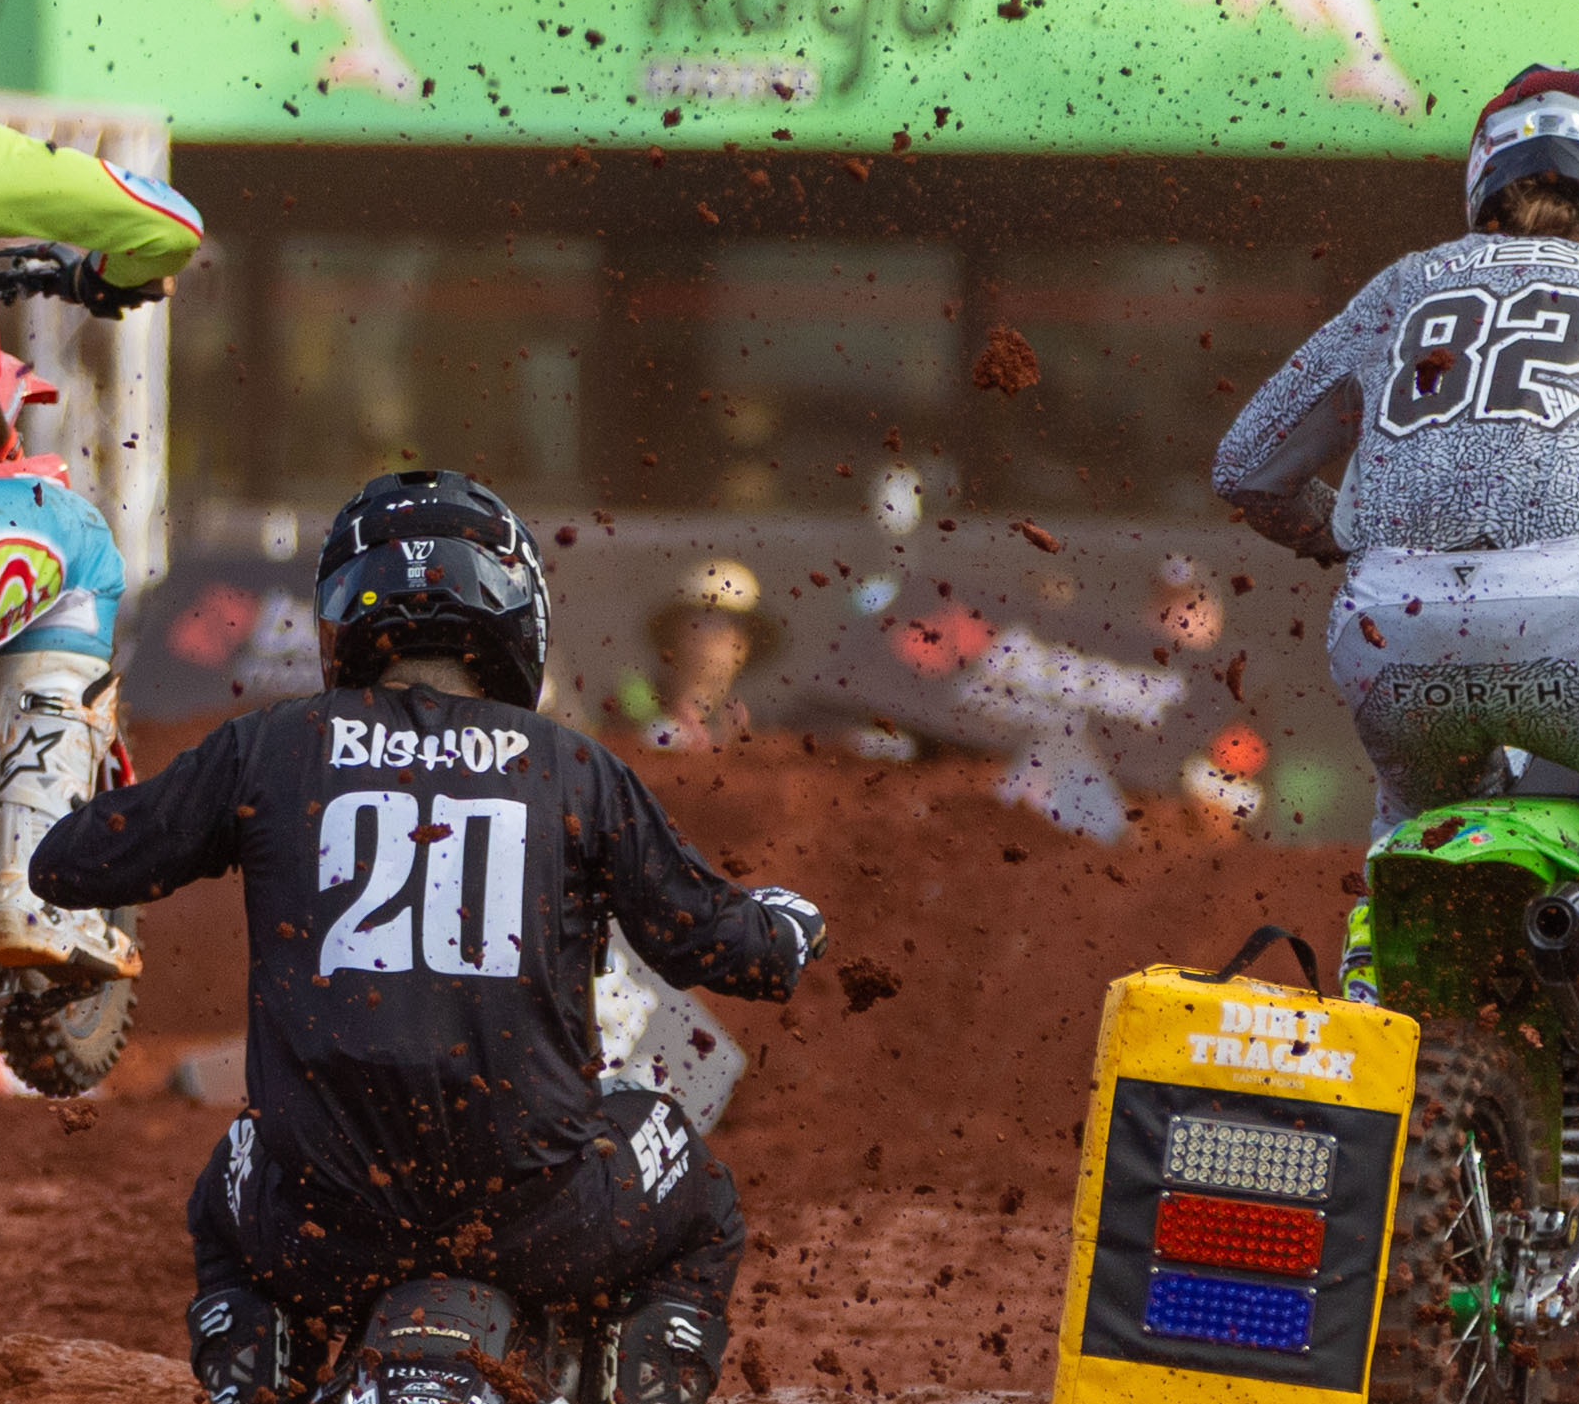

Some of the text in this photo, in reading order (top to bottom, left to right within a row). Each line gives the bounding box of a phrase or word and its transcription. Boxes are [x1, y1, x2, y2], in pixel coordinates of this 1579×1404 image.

[1391, 680, 1563, 707] FORTH
[329, 716, 529, 774] BISHOP
[318, 791, 527, 978] 20
[1220, 1001, 1330, 1044] DIRT
[1188, 1033, 1356, 1082] TRACKX
